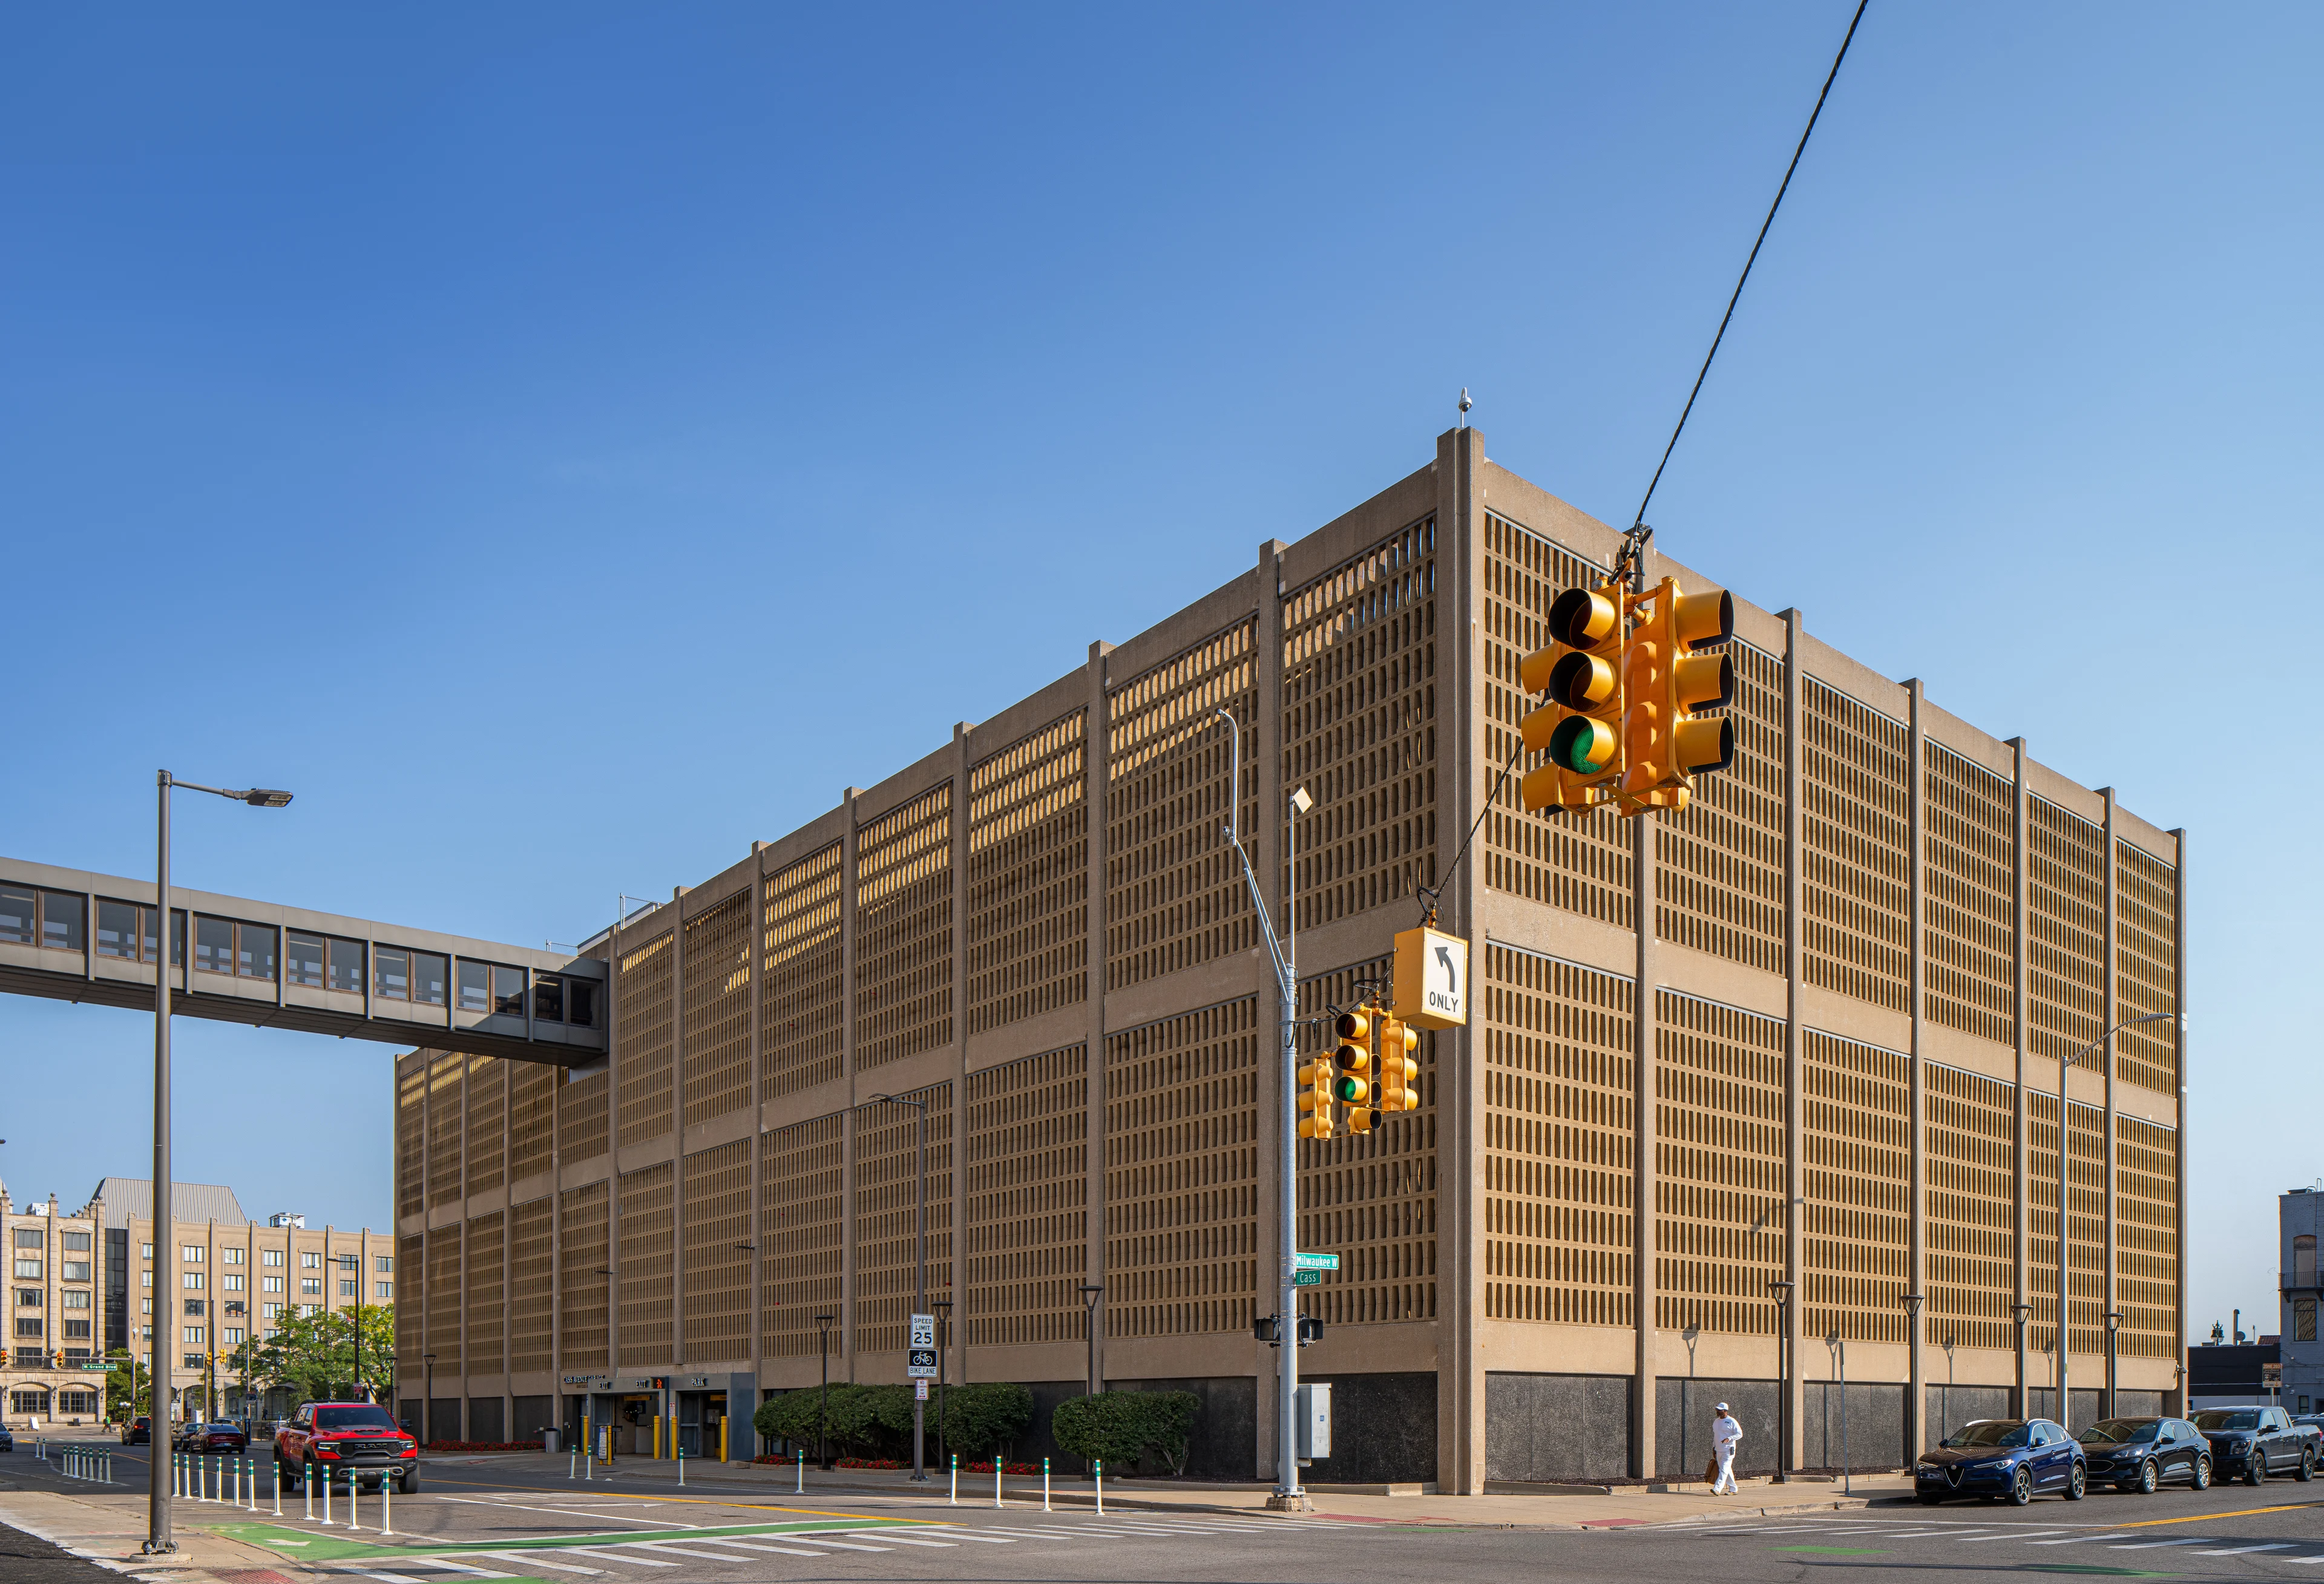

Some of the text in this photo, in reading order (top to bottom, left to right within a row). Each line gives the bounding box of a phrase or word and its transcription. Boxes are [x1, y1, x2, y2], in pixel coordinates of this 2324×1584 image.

[1430, 991, 1459, 1012] ONLY
[1296, 1255, 1338, 1267] Milwaukee W
[1300, 1273, 1316, 1283] Cass
[914, 1332, 932, 1344] 25
